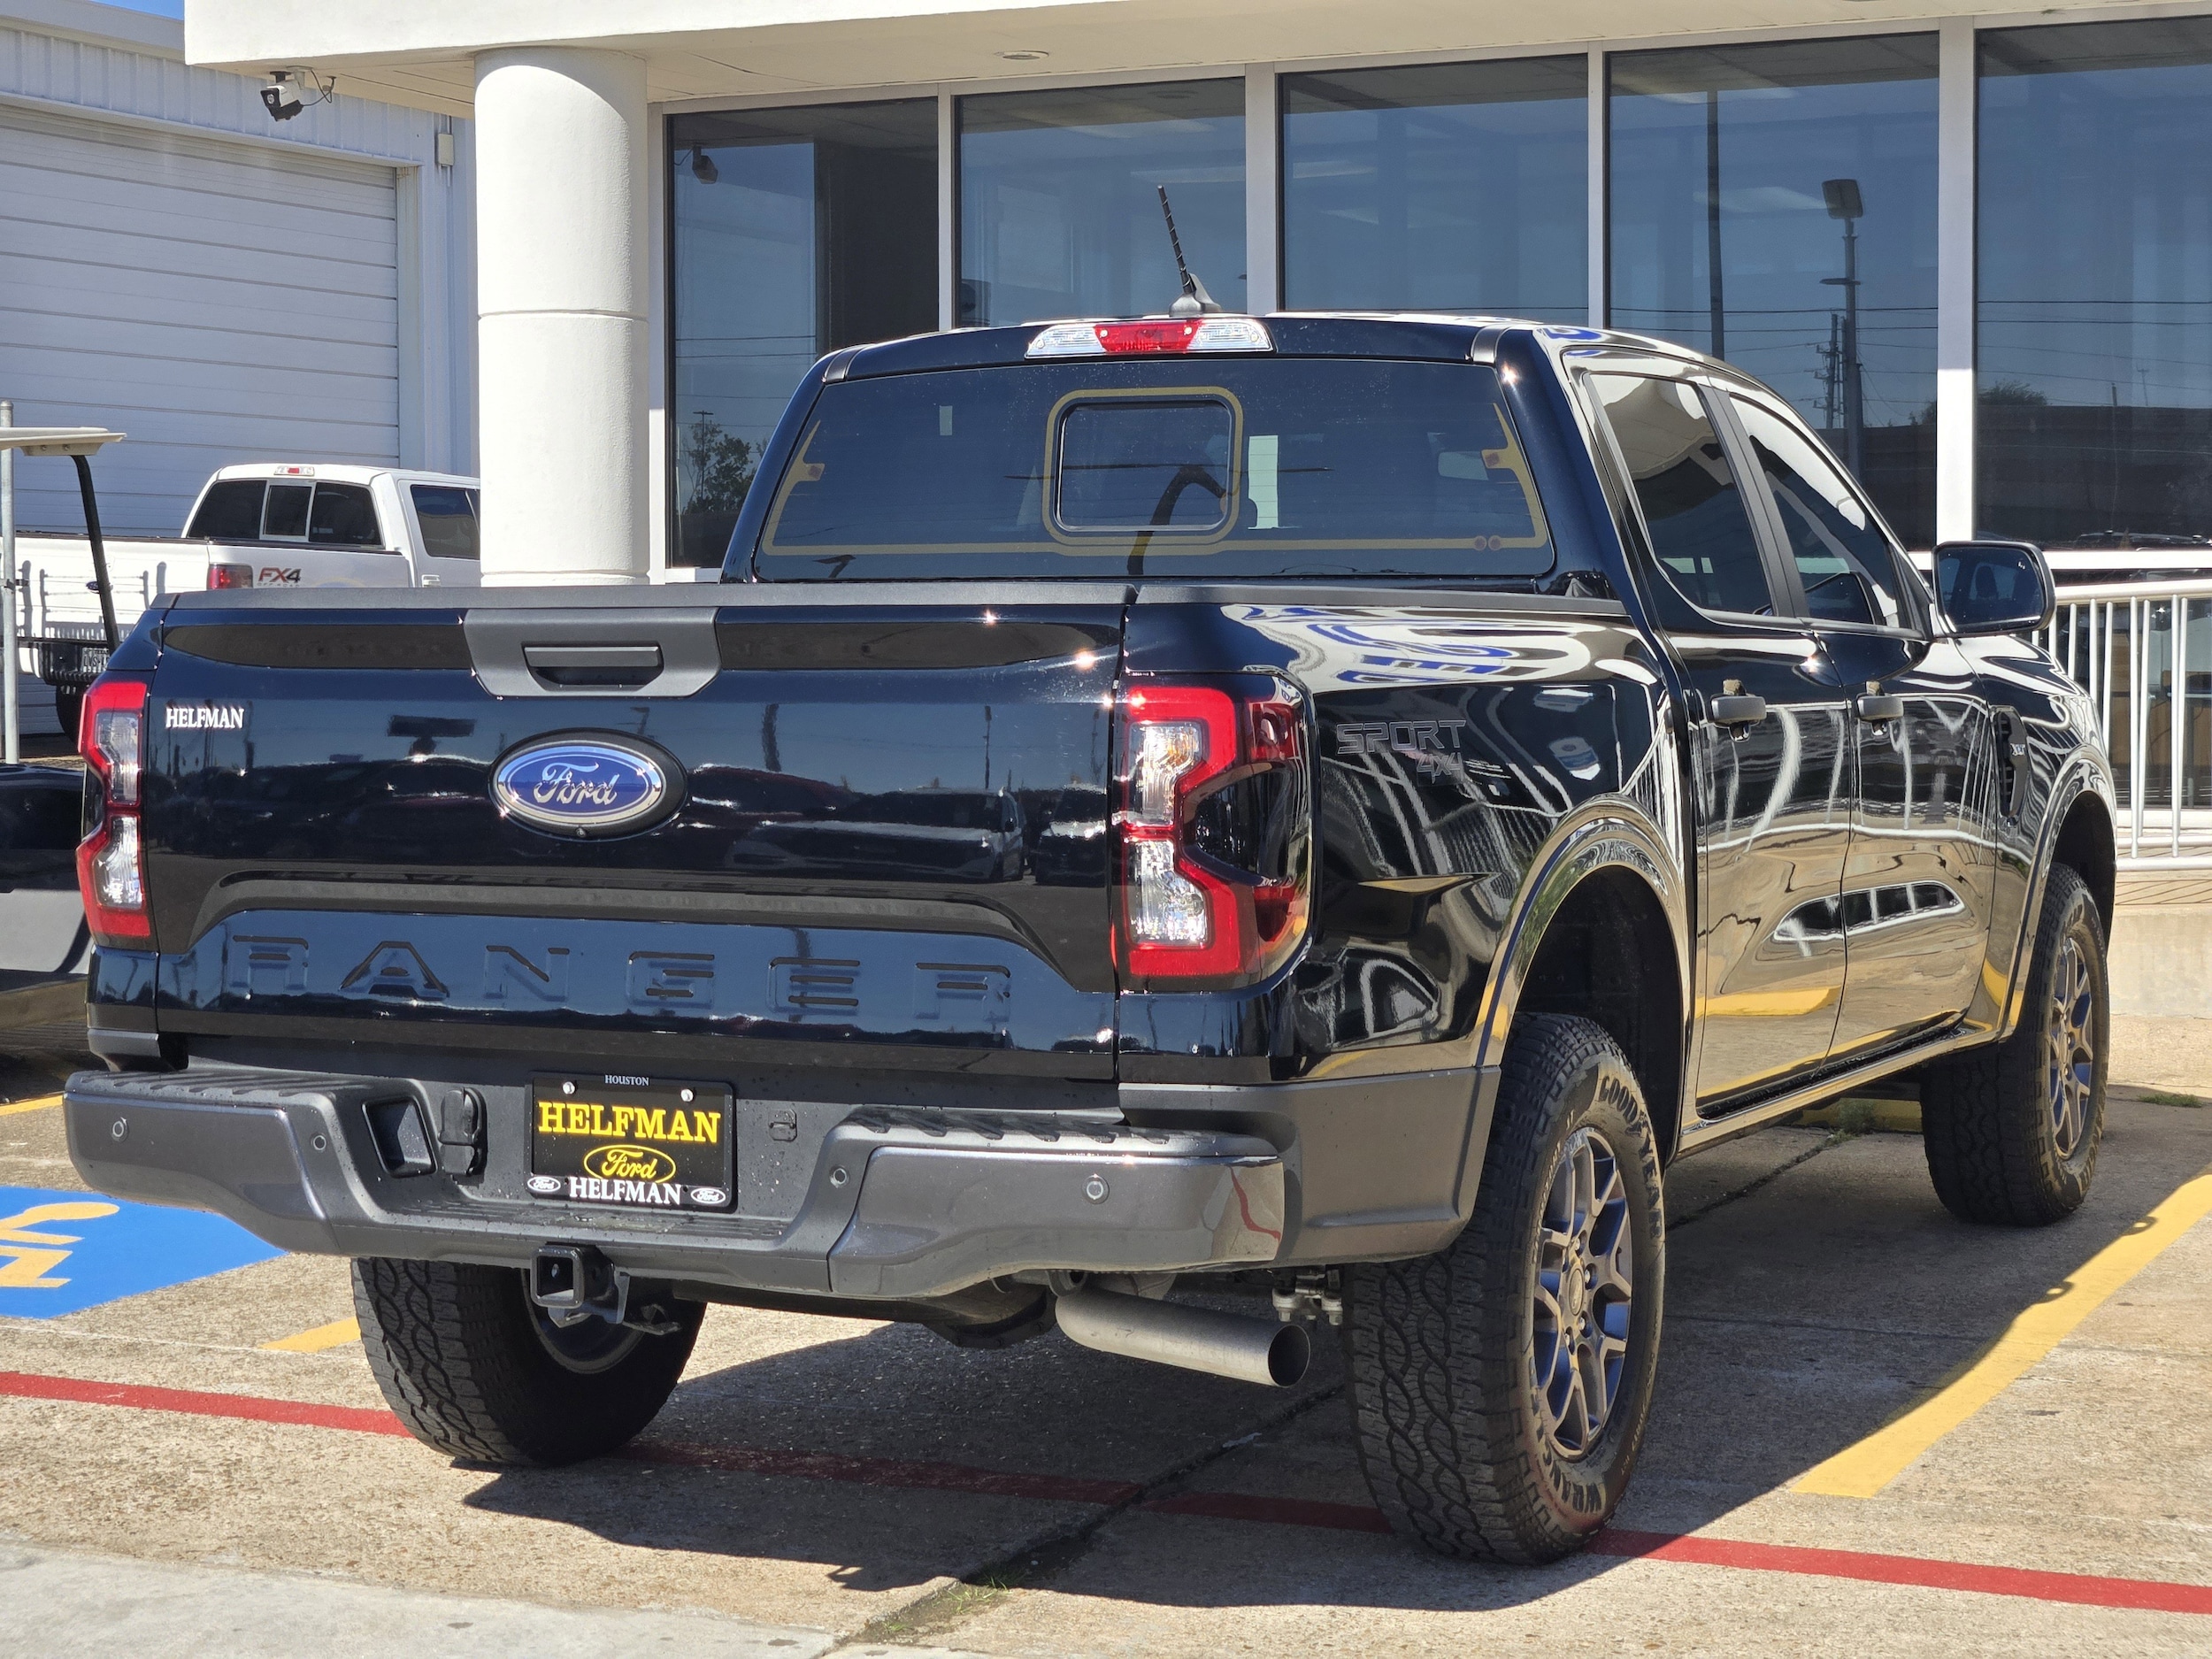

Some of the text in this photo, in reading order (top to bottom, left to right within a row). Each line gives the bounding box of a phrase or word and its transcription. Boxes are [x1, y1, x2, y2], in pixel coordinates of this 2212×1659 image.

[258, 567, 302, 583] FX4
[165, 707, 244, 728] HELFMAN
[1336, 719, 1466, 754] SPORT
[534, 762, 619, 805] Ford
[229, 933, 1011, 1023] RANGER
[604, 1074, 649, 1087] HOUSTON
[538, 1102, 721, 1143] HELFMAN
[601, 1148, 657, 1179] Ford
[568, 1176, 682, 1205] HELFMAN
